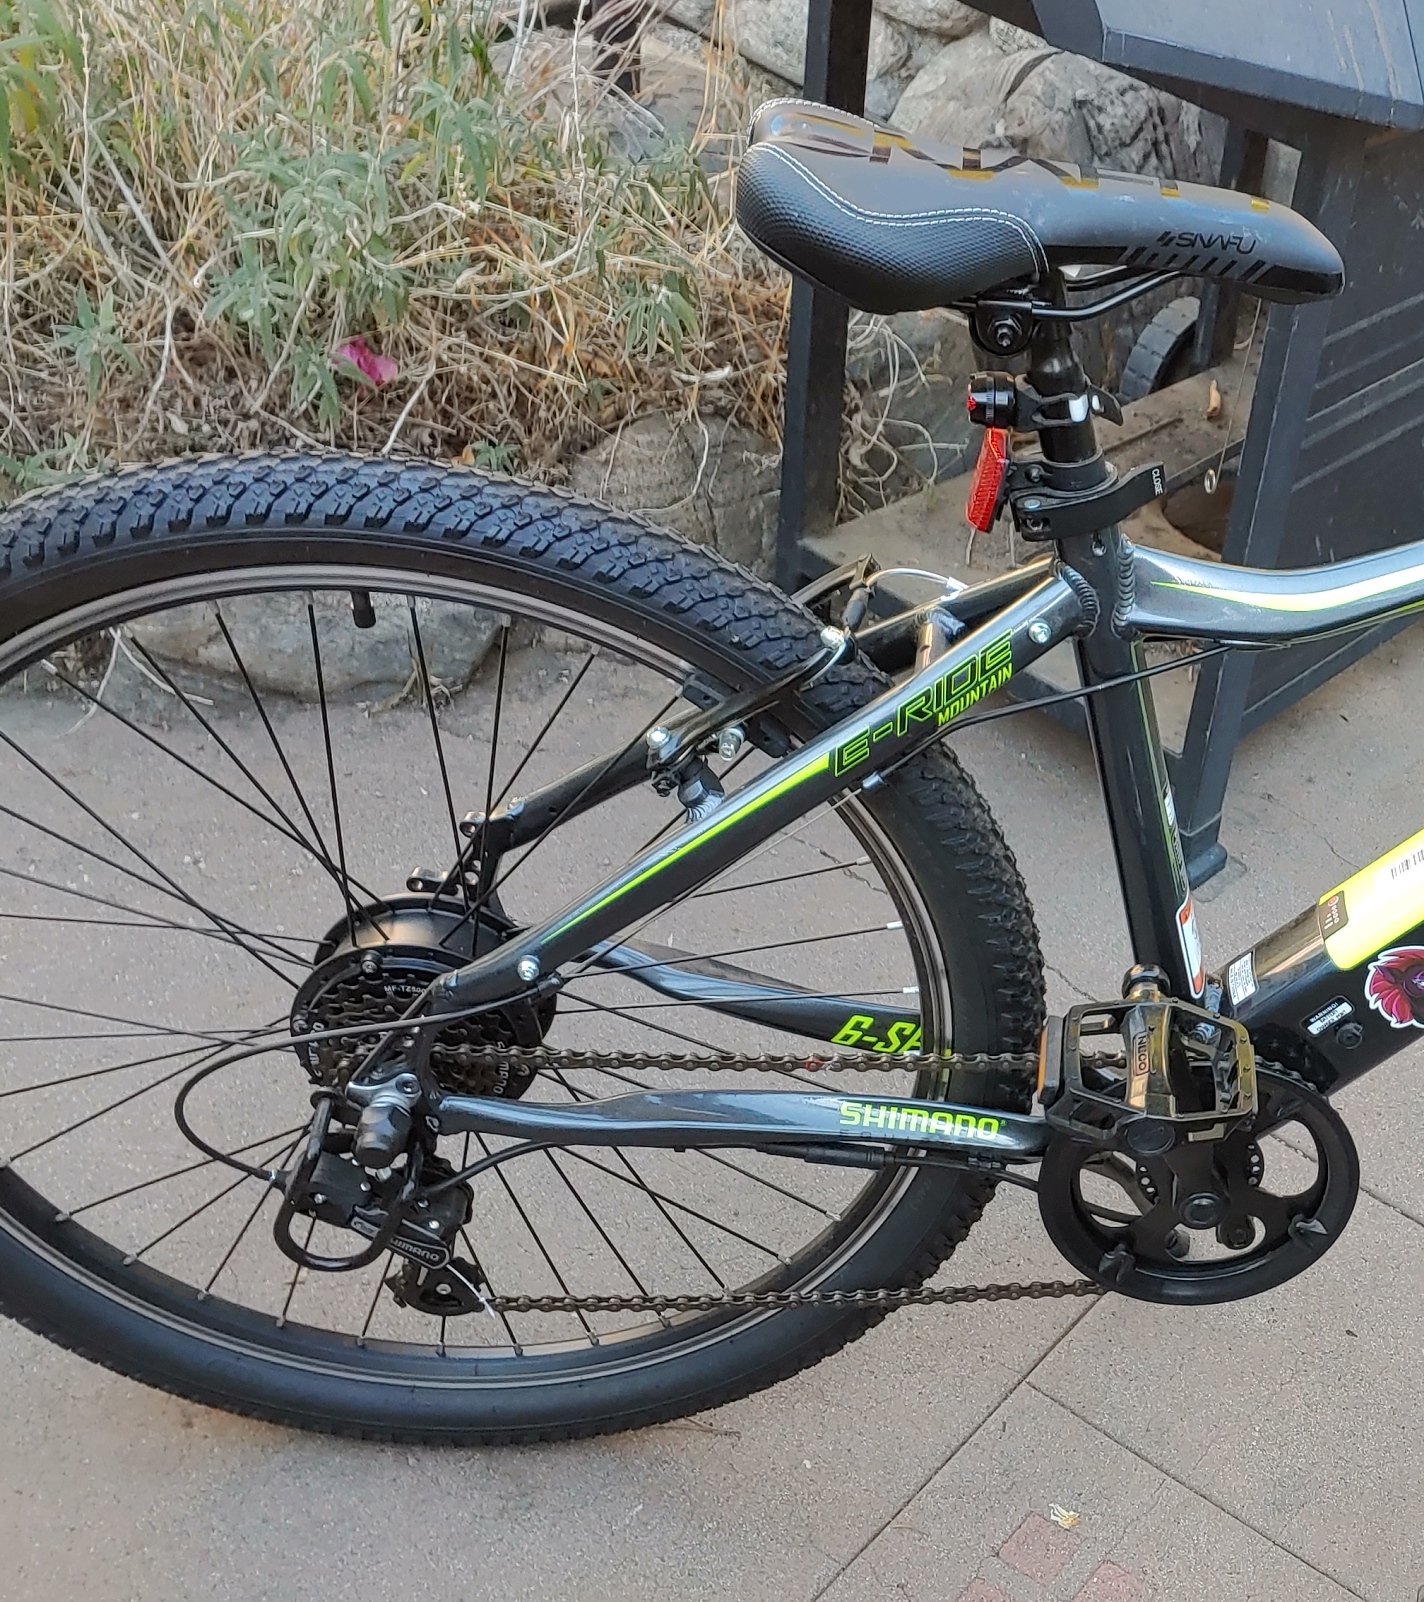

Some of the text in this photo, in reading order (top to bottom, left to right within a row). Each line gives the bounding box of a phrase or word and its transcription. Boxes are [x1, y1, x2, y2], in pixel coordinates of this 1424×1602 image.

[1175, 231, 1257, 255] SNAFU
[1152, 468, 1164, 496] CLOSE
[834, 628, 1013, 778] E-RIDE
[937, 663, 1013, 727] MOUNTAIN
[1309, 1001, 1339, 1023] WARNING!
[1137, 1035, 1147, 1071] NECO
[839, 1100, 1000, 1141] SHIMANO
[388, 1237, 441, 1263] HIMANO
